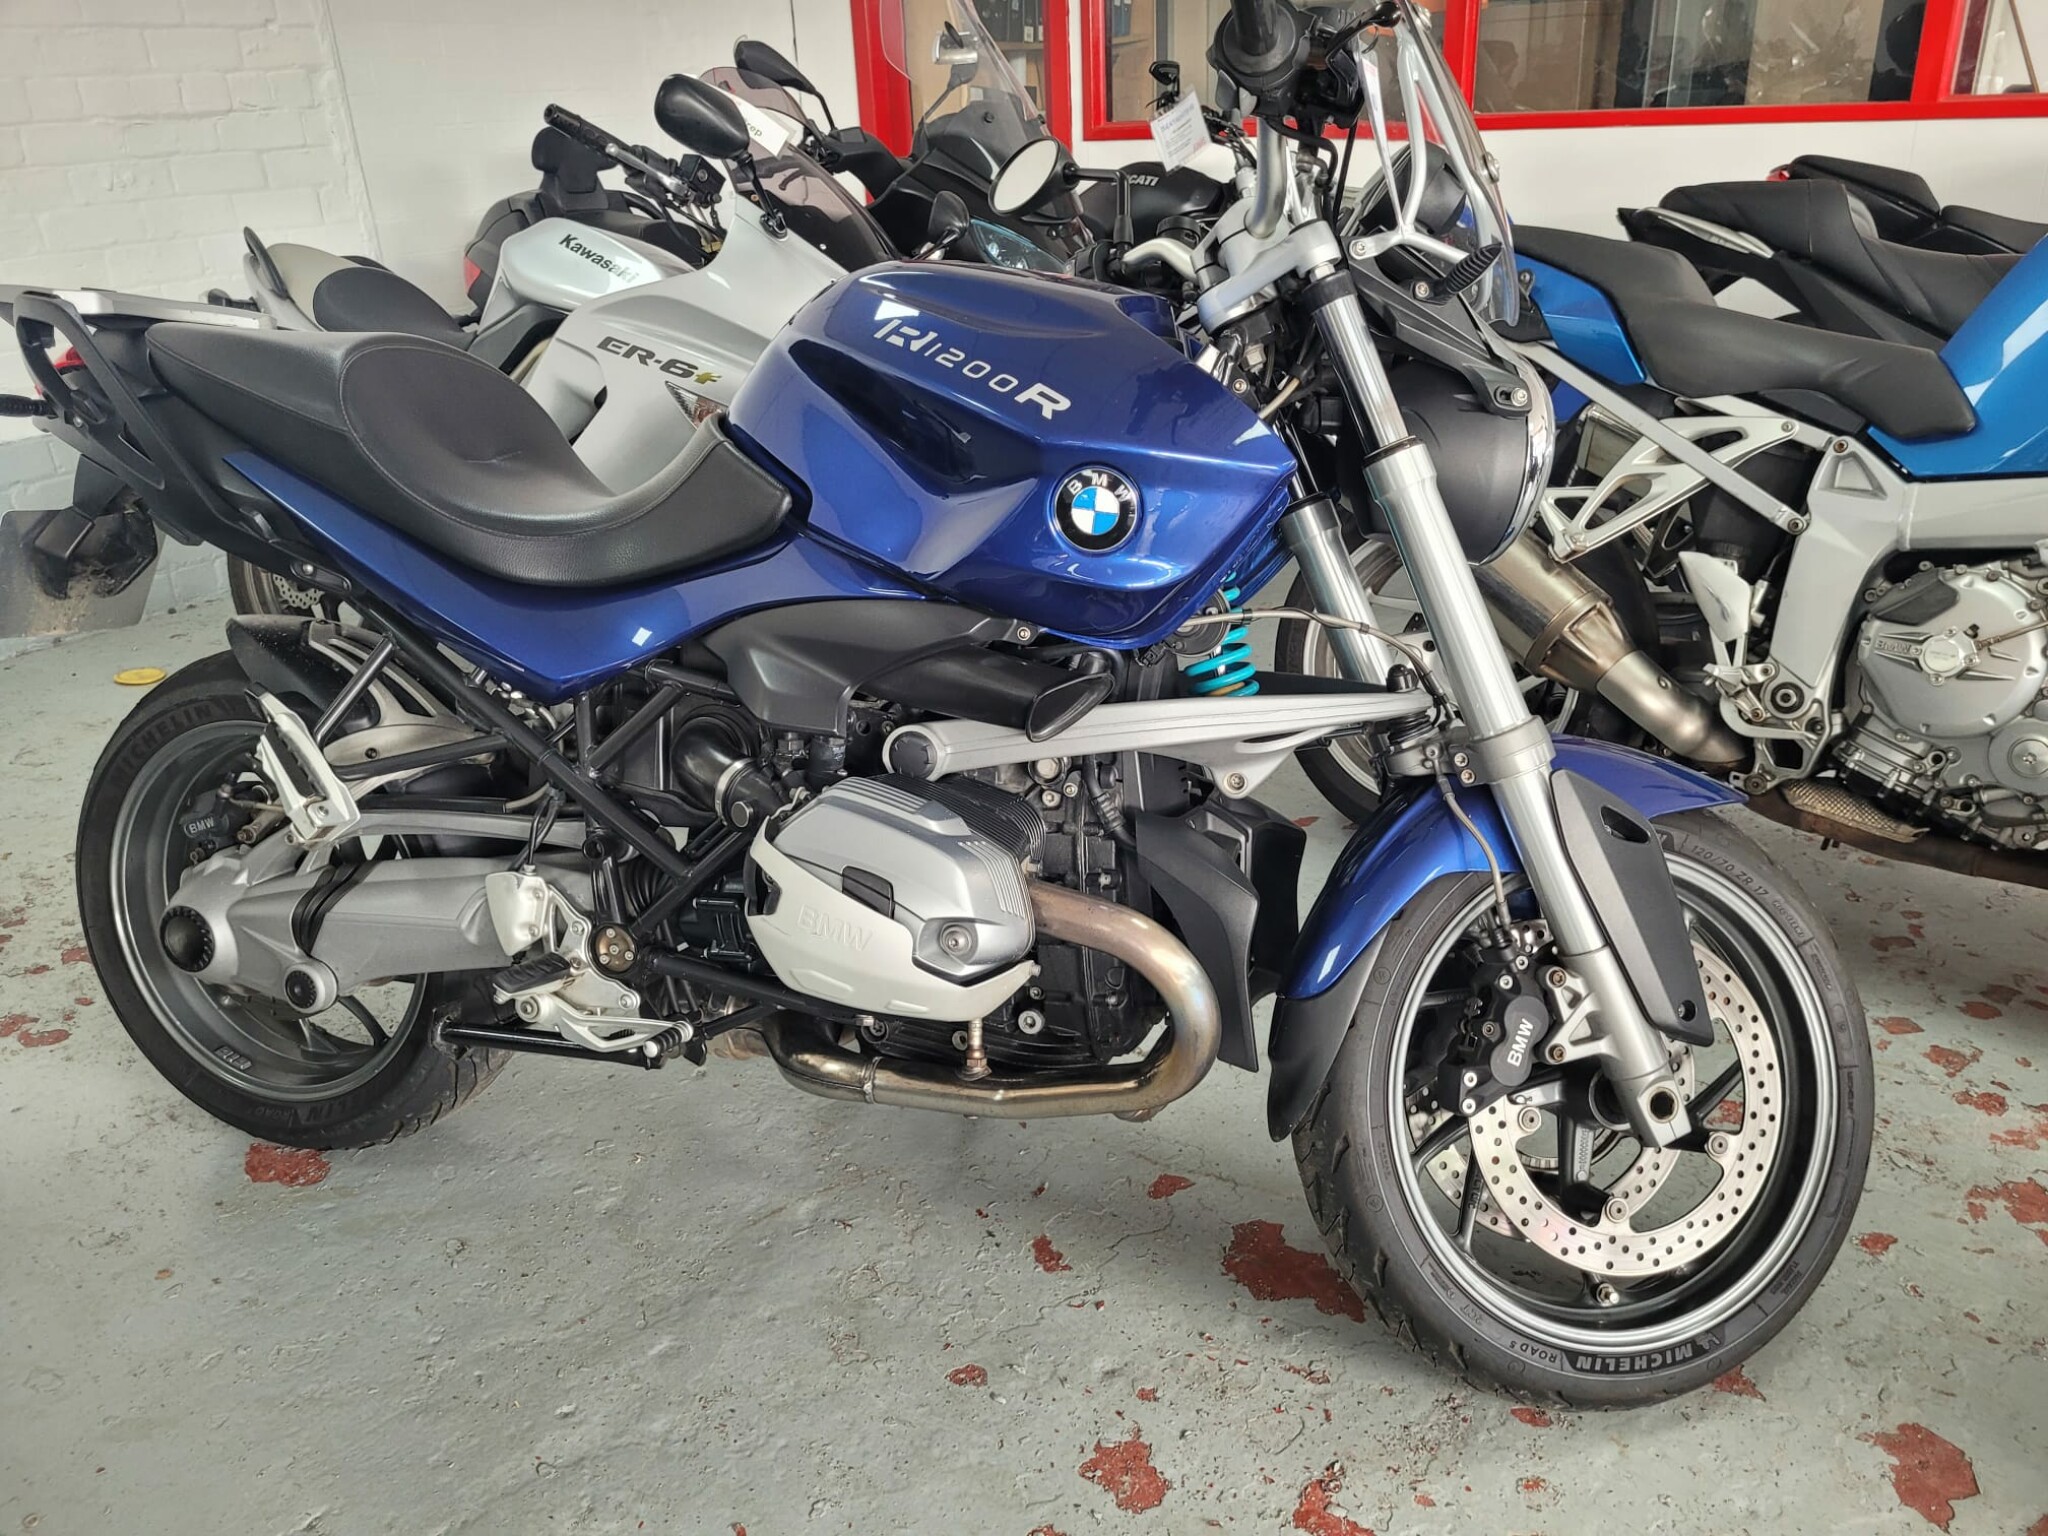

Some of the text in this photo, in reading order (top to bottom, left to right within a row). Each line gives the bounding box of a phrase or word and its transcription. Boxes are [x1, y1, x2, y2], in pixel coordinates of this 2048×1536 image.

[1127, 174, 1160, 187] CATI
[559, 234, 640, 283] Kawasaki
[1066, 473, 1134, 502] BMW
[189, 816, 214, 834] BMW
[1691, 845, 1769, 897] 120/70 ZR 17
[796, 904, 873, 951] BMW
[1507, 1018, 1534, 1067] BMW
[1520, 1342, 1558, 1364] ROAD
[1576, 1342, 1694, 1371] MICHELIN
